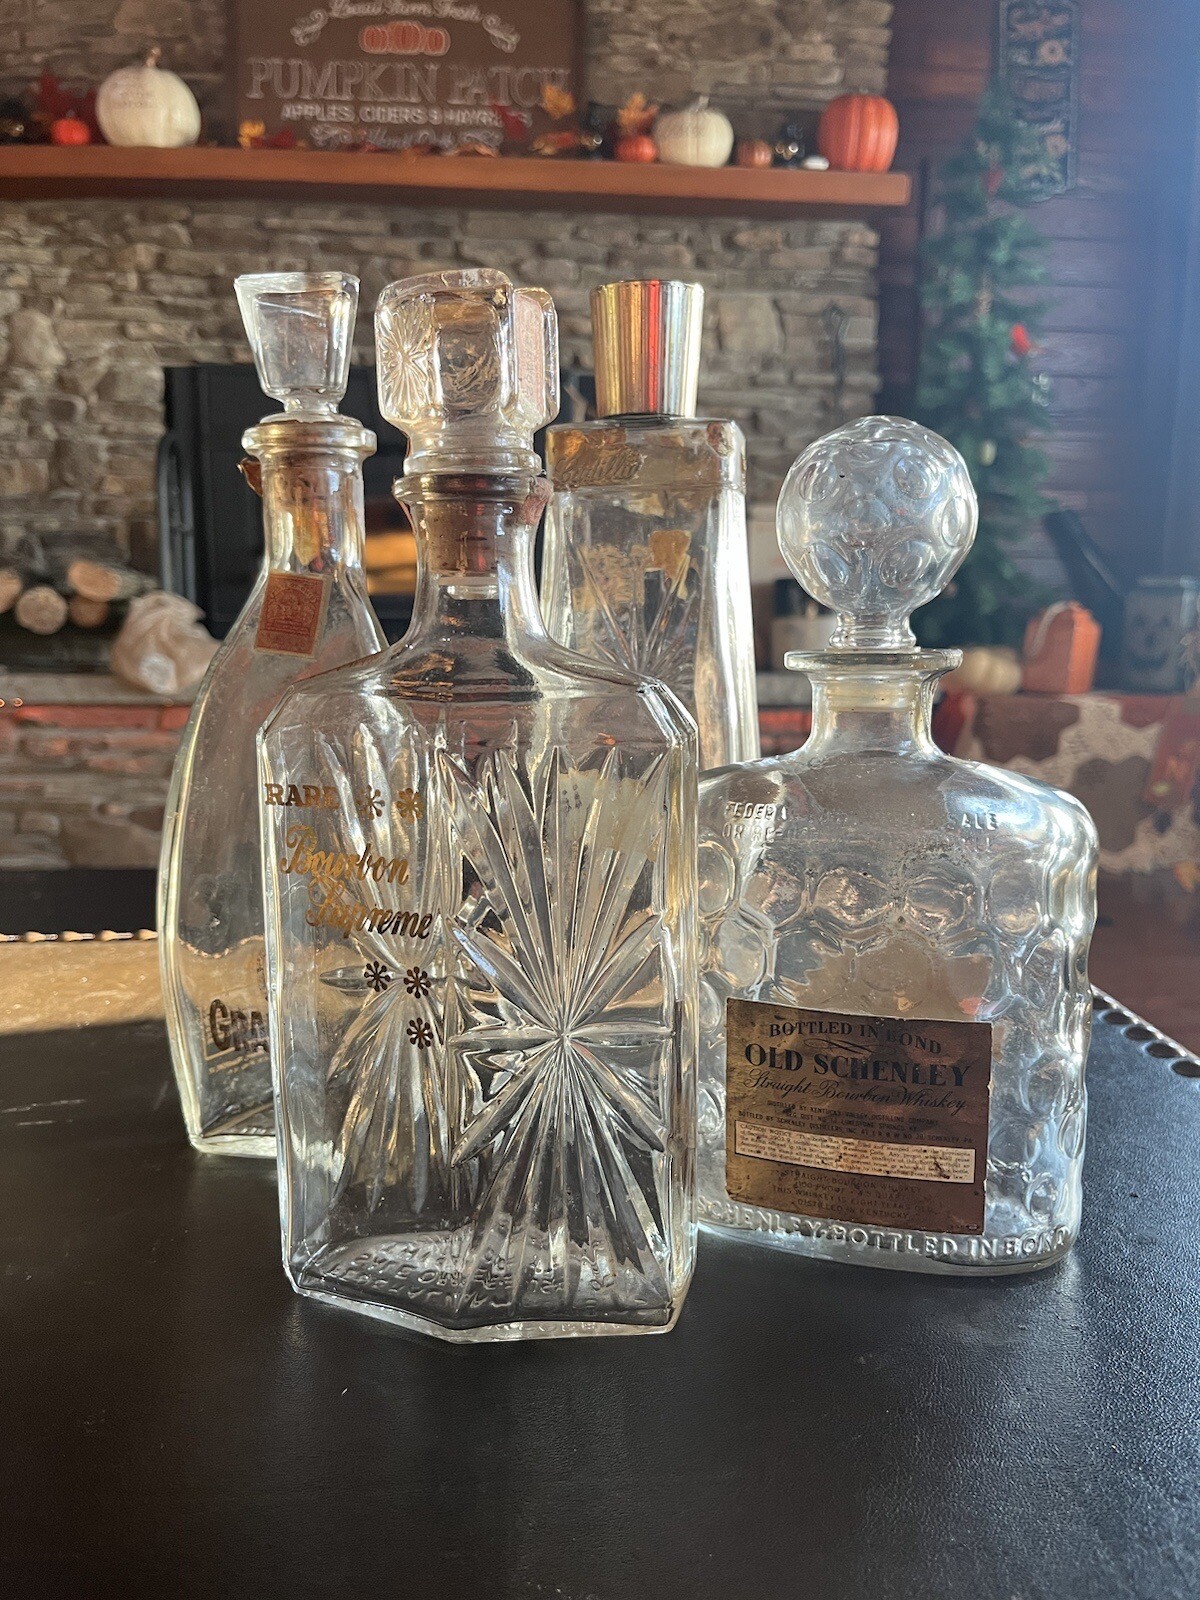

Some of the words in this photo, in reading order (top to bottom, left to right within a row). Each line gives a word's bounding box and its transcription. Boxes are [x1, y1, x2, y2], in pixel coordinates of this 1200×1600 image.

[245, 57, 441, 104] PUMPKIN
[281, 103, 356, 122] APPLES
[359, 105, 428, 125] CIDERS
[264, 783, 341, 811] RARE
[279, 824, 410, 886] Bourbon
[305, 875, 433, 940] Supreme
[768, 1021, 853, 1038] BOTTLED
[859, 1023, 878, 1039] IN
[886, 1028, 942, 1054] BOND
[744, 1042, 803, 1072] OLD
[813, 1052, 971, 1087] SCHENLEY
[743, 1068, 812, 1099] Straight
[813, 1080, 892, 1104] Bourbon
[898, 1085, 967, 1117] Whiskey
[967, 1236, 999, 1260] IN
